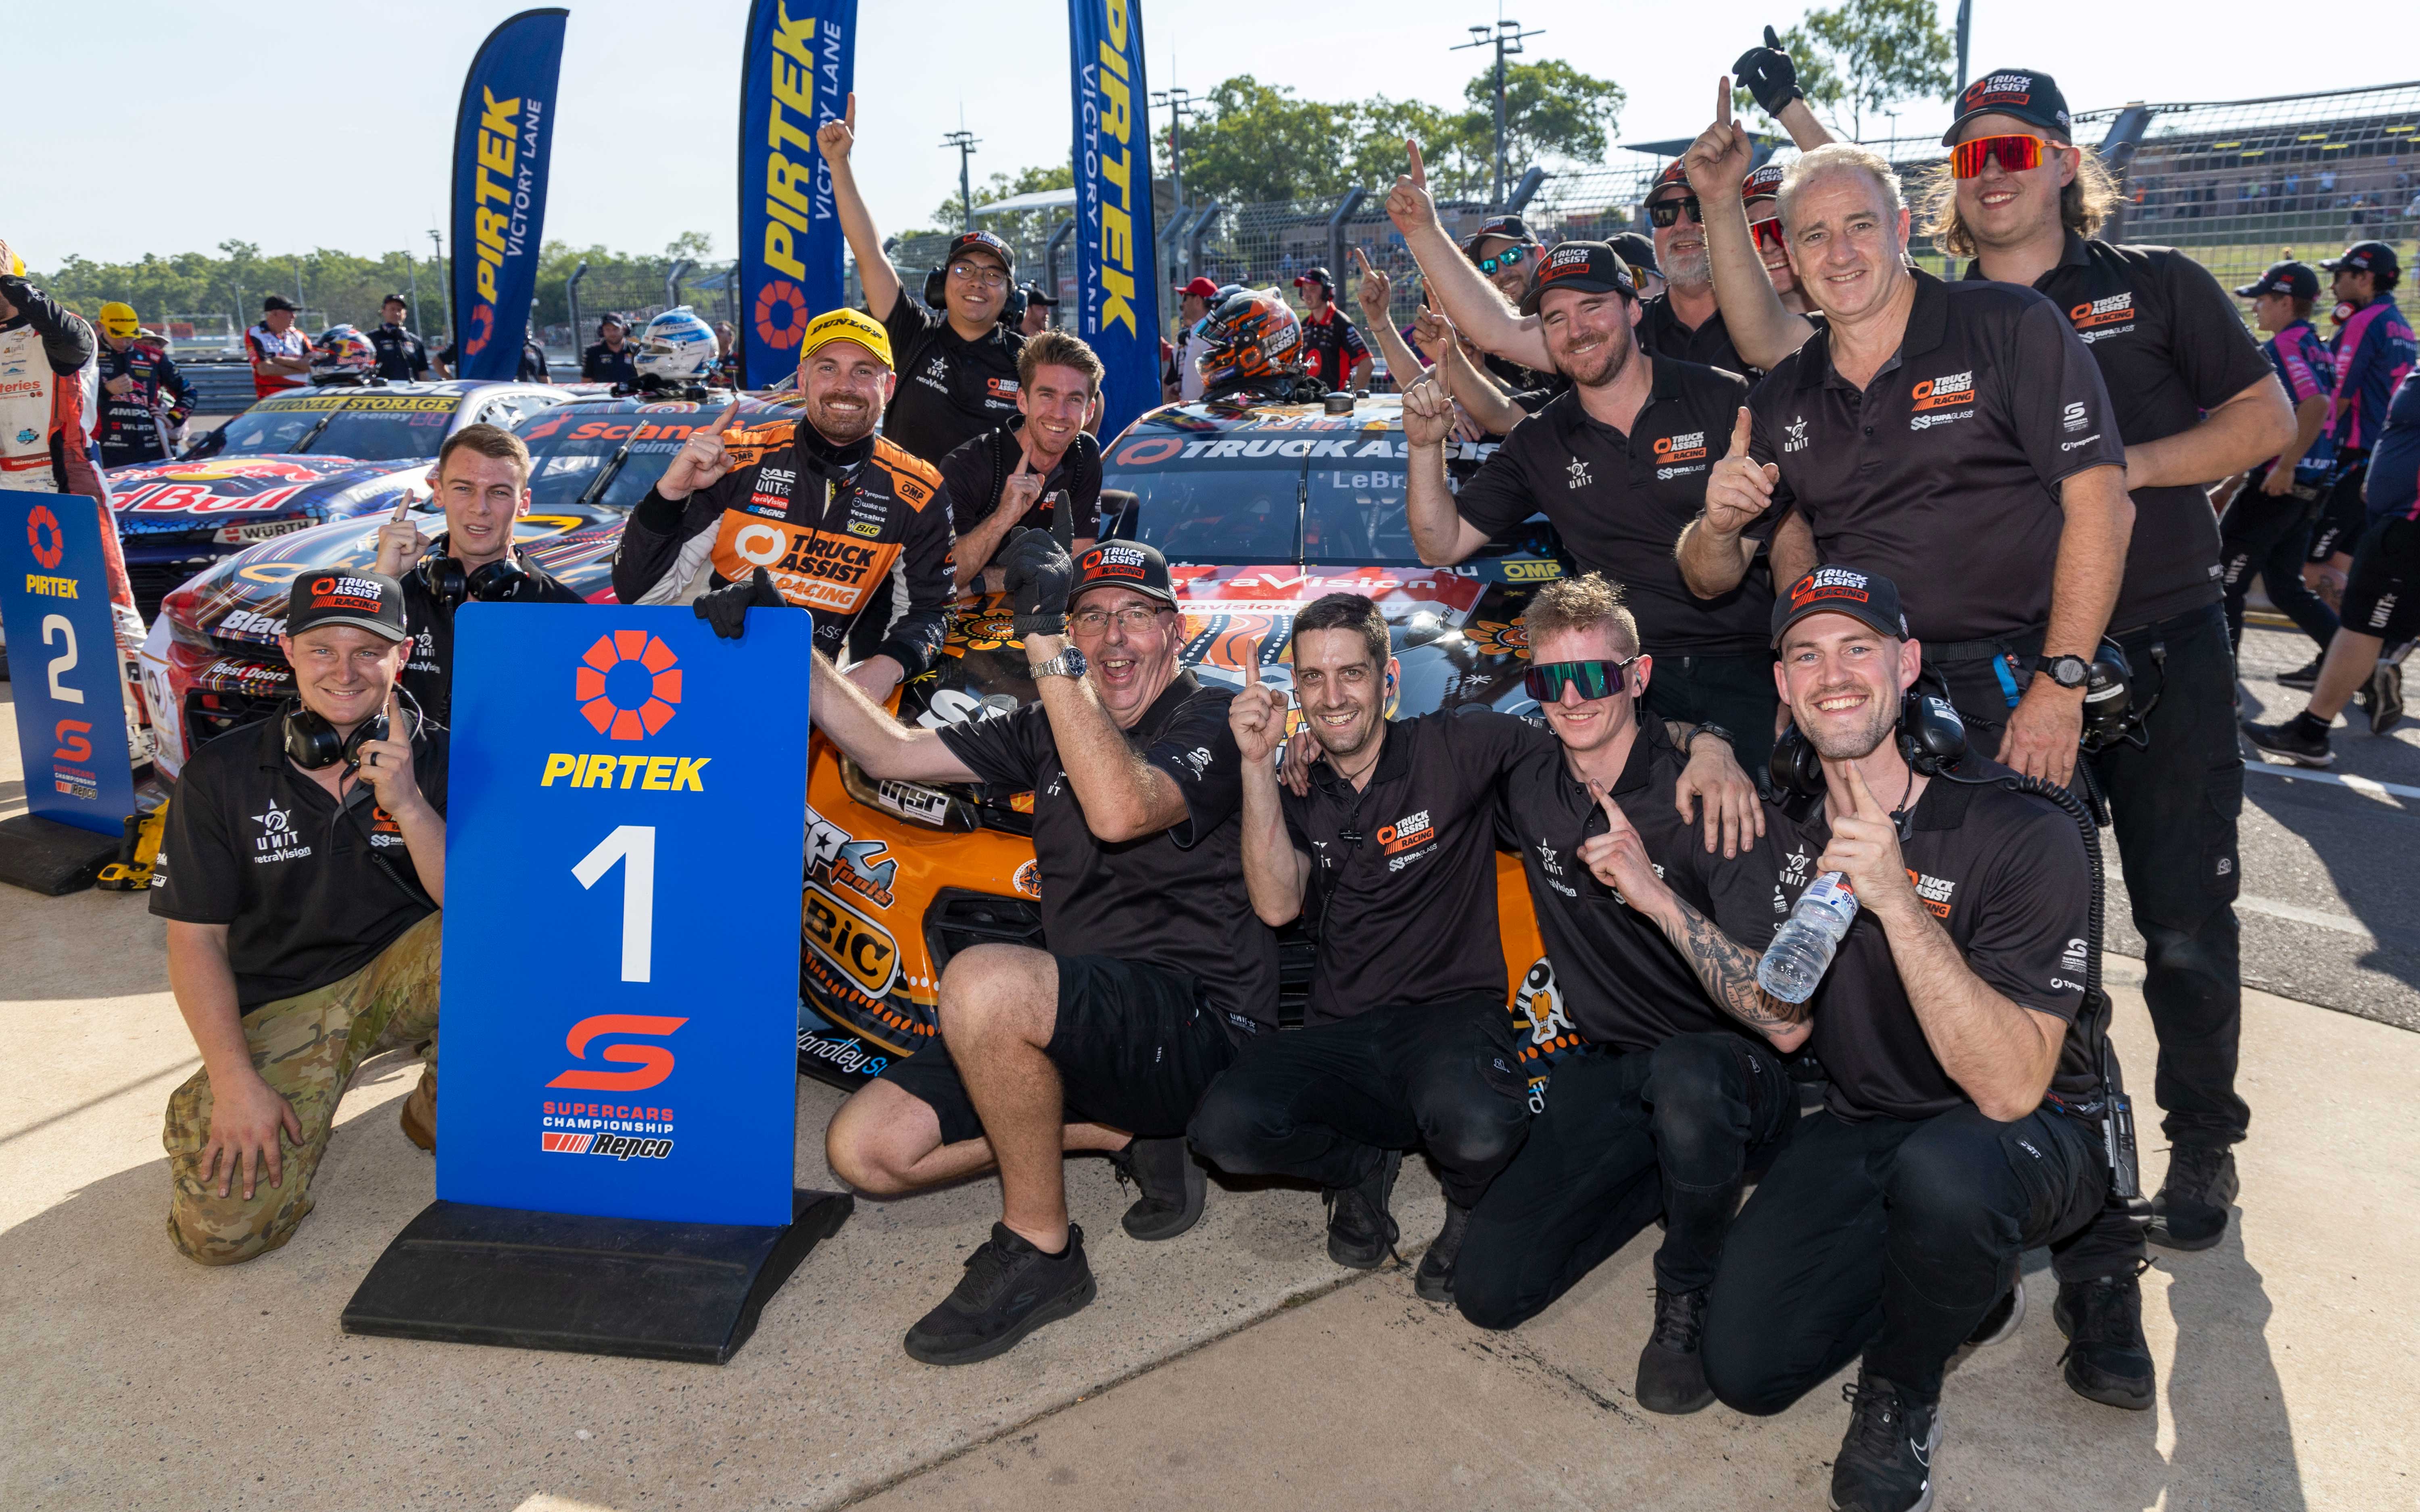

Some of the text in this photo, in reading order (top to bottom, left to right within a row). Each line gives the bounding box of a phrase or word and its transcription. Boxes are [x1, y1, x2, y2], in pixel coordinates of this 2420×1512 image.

[1987, 75, 2032, 85] TRUCK
[1982, 83, 2030, 94] ASSIST
[815, 20, 841, 220] VICTRY LANE
[764, 0, 816, 282] PIRTEK
[1083, 63, 1098, 228] VICTORY
[507, 98, 542, 256] VICTORY LANE
[1099, 0, 1136, 340] PIRTEK
[1755, 169, 1781, 178] TRUC
[1752, 175, 1782, 187] ASSIS
[475, 85, 521, 304] PIRTEK
[1553, 249, 1590, 259] TRUCK
[1551, 256, 1589, 269] ASSIST
[1553, 264, 1587, 276] RACING
[2090, 300, 2131, 315] ASSIST
[2093, 292, 2132, 308] TRUCK
[2095, 310, 2131, 323] RACING
[811, 318, 882, 339] DUNLOP
[1262, 324, 1296, 347] TRUCK
[2095, 325, 2134, 338] SUPAGLASS
[1264, 333, 1296, 359] ASSIST
[927, 367, 945, 380] UNIT
[1935, 371, 1972, 387] TRUCK
[0, 380, 41, 394] teries
[916, 375, 949, 394] retraVision
[1931, 380, 1972, 396] ASSIST
[346, 398, 451, 411] STORAGE
[1934, 393, 1971, 405] RACING
[348, 412, 411, 422] Feeney
[1932, 410, 1974, 422] SUPAGLASS
[1672, 431, 1704, 442] TRUCK
[1671, 440, 1703, 452] ASSIST
[1784, 437, 1809, 452] UNIT
[11, 456, 52, 466] Heimgartn
[1674, 450, 1704, 460] RACING
[1673, 465, 1705, 473] SUPAGLASS
[1569, 475, 1592, 489] UNIT
[130, 483, 315, 514] Bull
[901, 483, 924, 500] OMP
[862, 501, 878, 510] wake
[850, 509, 886, 523] Versalux
[793, 534, 877, 567] TRUCK
[1104, 547, 1146, 559] TRUCK
[776, 553, 868, 584] ASSIST
[1101, 555, 1145, 567] ASSIST
[1102, 566, 1143, 577] RACING
[1504, 563, 1561, 578] OMP
[1816, 569, 1869, 583] TRUCK
[26, 574, 79, 599] PIRTEK
[339, 577, 384, 591] TRUCK
[1173, 573, 1437, 589] etraVision
[1812, 577, 1867, 589] ASSIST
[333, 585, 382, 600] ASSIST
[776, 577, 856, 605] RACING
[1814, 589, 1867, 600] RACING
[334, 597, 378, 610] RACING
[220, 609, 287, 635] Blac
[42, 614, 84, 704] 2
[213, 662, 289, 681] Best Doors
[53, 764, 96, 779] SUPERCARS
[55, 772, 97, 786] CHAMPIONSHIP
[541, 753, 711, 791] PIRTEK
[72, 783, 98, 800] Repco
[1396, 810, 1429, 828] TRUCK
[1396, 818, 1430, 839] ASSIST
[256, 831, 298, 850] UNIT
[1402, 830, 1432, 848] RACING
[255, 846, 312, 864] retraVision
[1403, 843, 1437, 862] SUPAGLASS
[1543, 861, 1563, 876] UNIT
[1779, 870, 1807, 887] UNIT
[571, 825, 655, 983] 1
[2062, 956, 2087, 964] SUPERCA
[2063, 980, 2085, 993] Tyrepo
[543, 1101, 674, 1122] SUPERCARS
[543, 1116, 674, 1134] CHAMPIONSHIP
[590, 1132, 675, 1161] Repco
